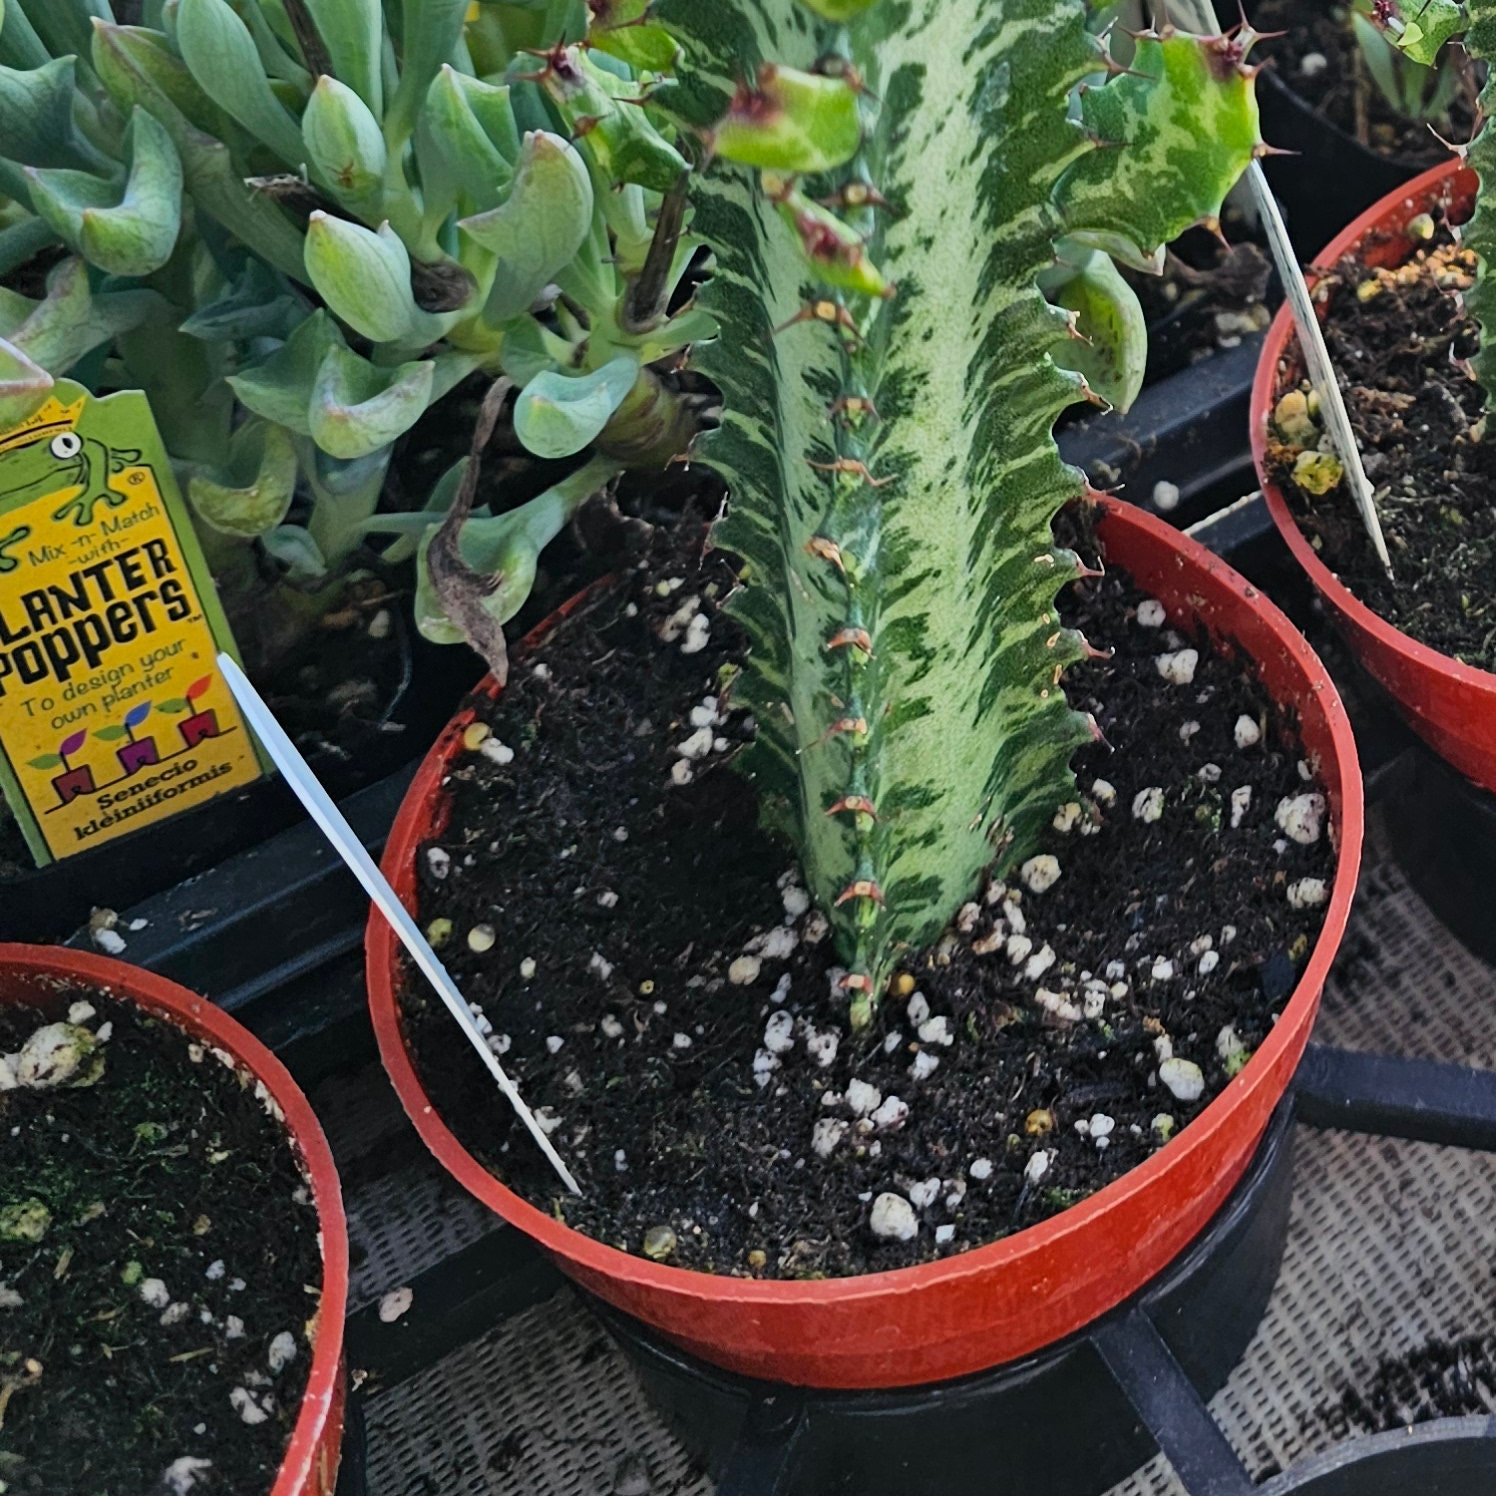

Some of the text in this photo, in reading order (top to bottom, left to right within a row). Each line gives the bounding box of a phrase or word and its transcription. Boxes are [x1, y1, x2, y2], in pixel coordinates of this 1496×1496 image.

[28, 544, 67, 567] Mix
[101, 502, 160, 537] Match
[0, 538, 178, 646] LANTER
[20, 639, 187, 717] To design your
[51, 667, 174, 729] own planter
[74, 761, 233, 840] kleiniiformis
[96, 759, 198, 810] Senecio
